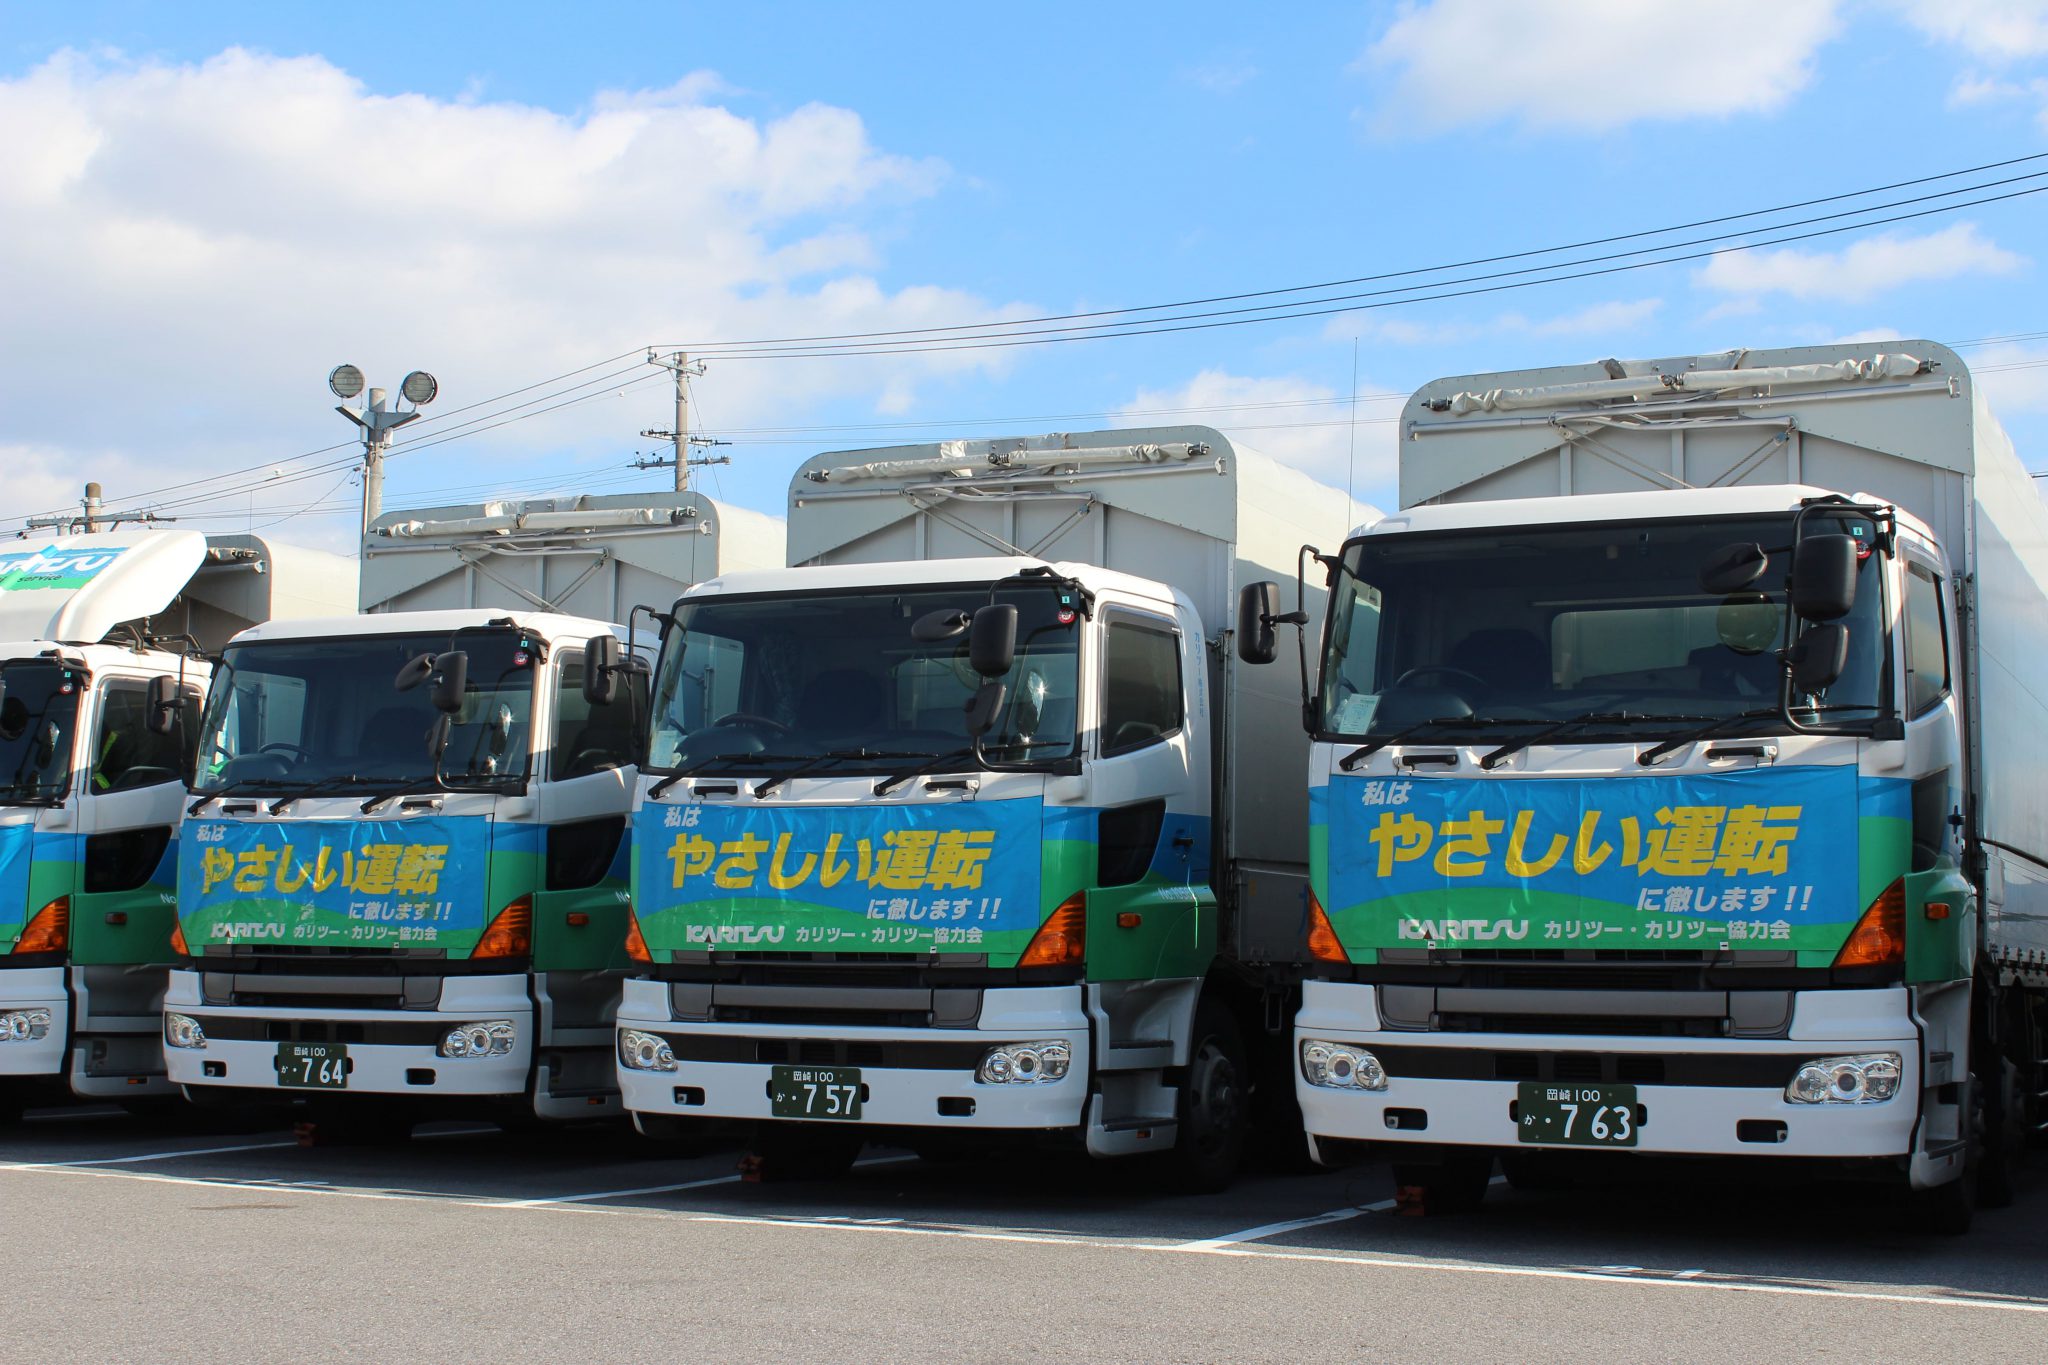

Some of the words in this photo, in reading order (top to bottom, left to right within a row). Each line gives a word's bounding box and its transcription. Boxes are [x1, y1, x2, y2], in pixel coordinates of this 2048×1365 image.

[1361, 781, 1413, 806] 私は
[664, 806, 702, 828] 私は
[196, 824, 227, 842] 私は
[1369, 804, 1803, 878] やさしい運転
[201, 843, 449, 895] やさしい運転
[667, 829, 996, 891] やさしい運転
[210, 922, 286, 938] KARITSU
[686, 925, 785, 943] KARITSU
[1398, 918, 1529, 941] KARITSU
[815, 1071, 834, 1082] 100
[1575, 1089, 1601, 1102] 100
